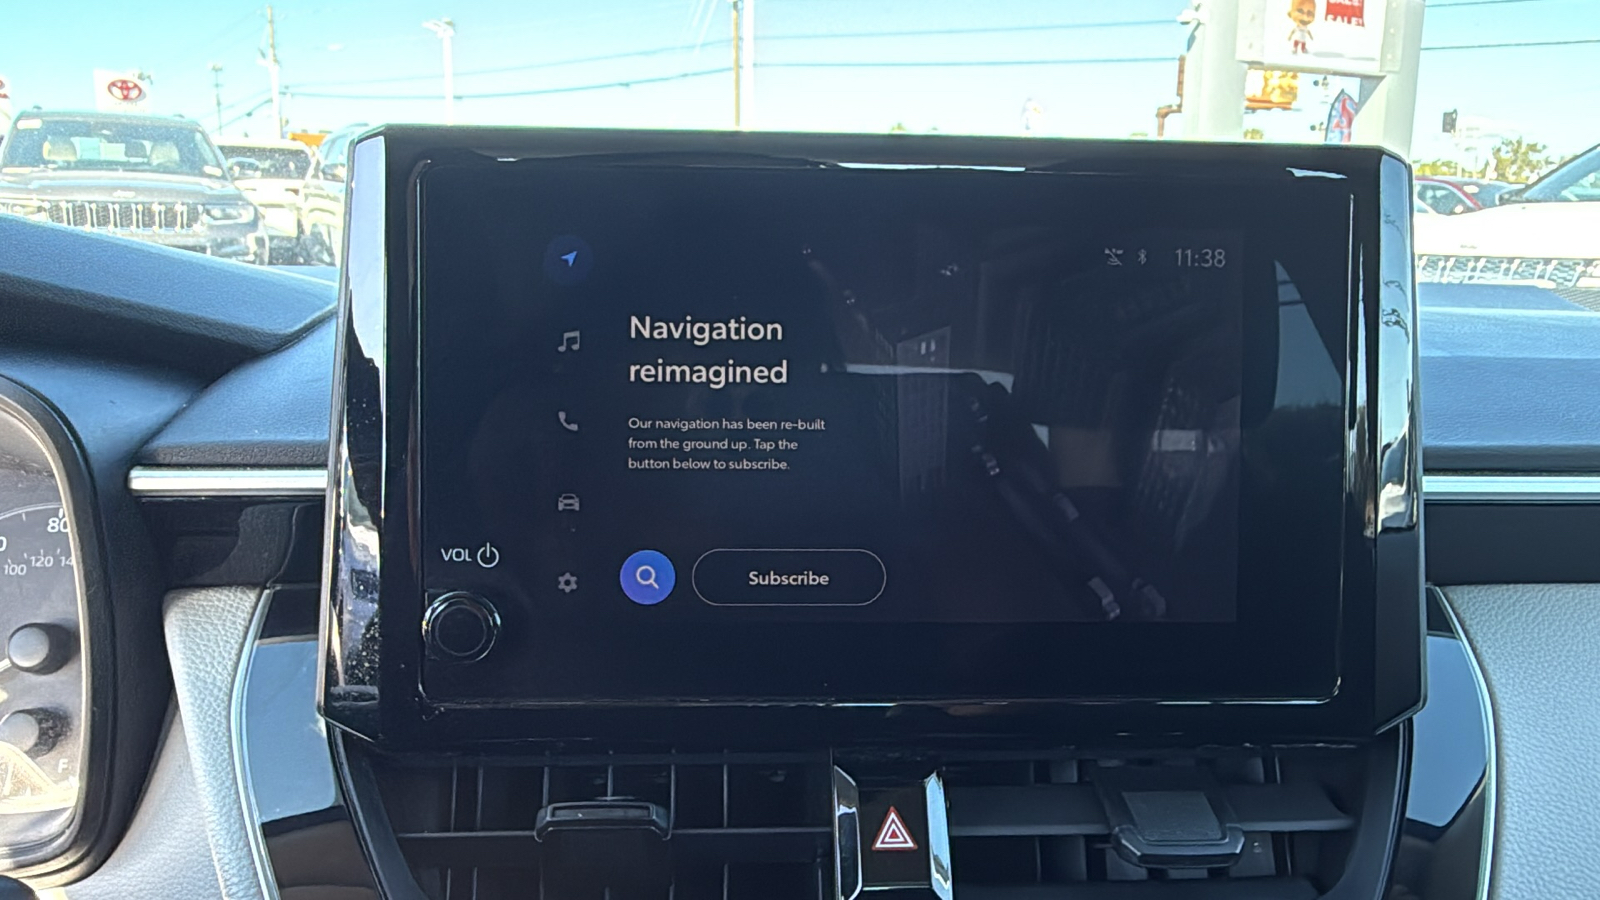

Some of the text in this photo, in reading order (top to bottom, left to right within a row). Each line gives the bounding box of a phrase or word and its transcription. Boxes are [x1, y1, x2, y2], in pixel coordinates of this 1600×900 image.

[1174, 248, 1227, 268] 11:38
[629, 315, 783, 346] Navigation
[629, 358, 789, 389] reimagined
[628, 417, 826, 431] Our navigation has been re-built
[628, 437, 799, 452] from the ground up. Tap the
[628, 457, 790, 470] button below to subscribe.
[47, 517, 69, 532] 80
[30, 556, 54, 567] 120
[440, 547, 473, 562] VOL
[3, 564, 27, 575] 100
[748, 570, 830, 587] Subscribe
[57, 758, 69, 774] F
